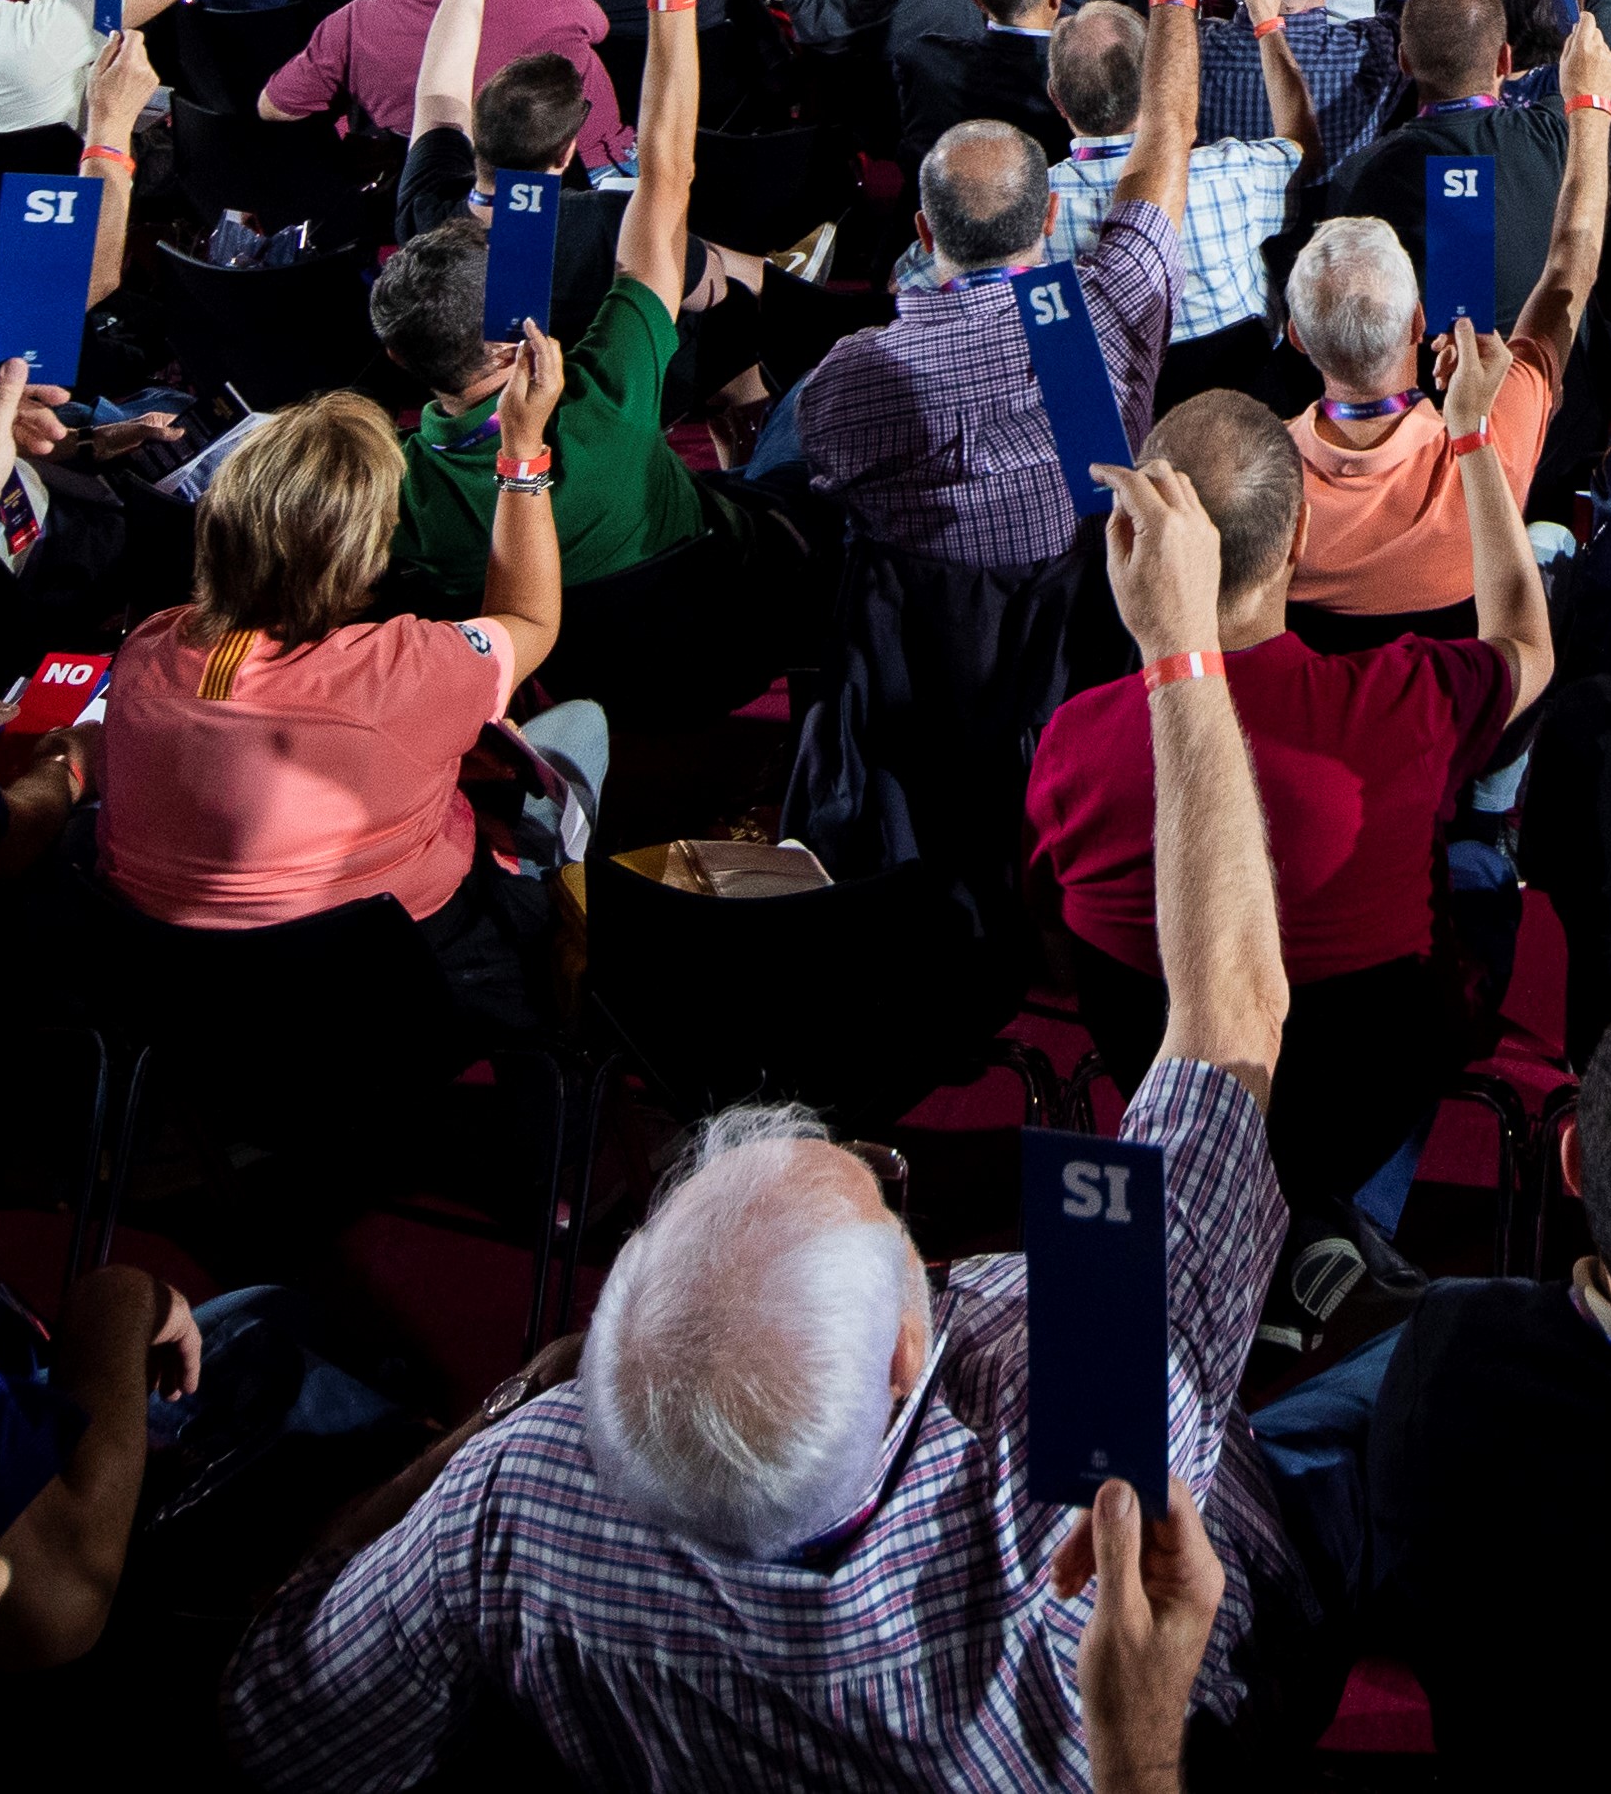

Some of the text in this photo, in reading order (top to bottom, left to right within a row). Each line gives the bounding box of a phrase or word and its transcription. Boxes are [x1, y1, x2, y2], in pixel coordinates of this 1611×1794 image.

[509, 183, 543, 213] SI
[1444, 169, 1478, 197] SI
[24, 190, 78, 223] SI
[1030, 282, 1070, 325] SI
[41, 662, 94, 686] NO
[1062, 1161, 1131, 1223] SI
